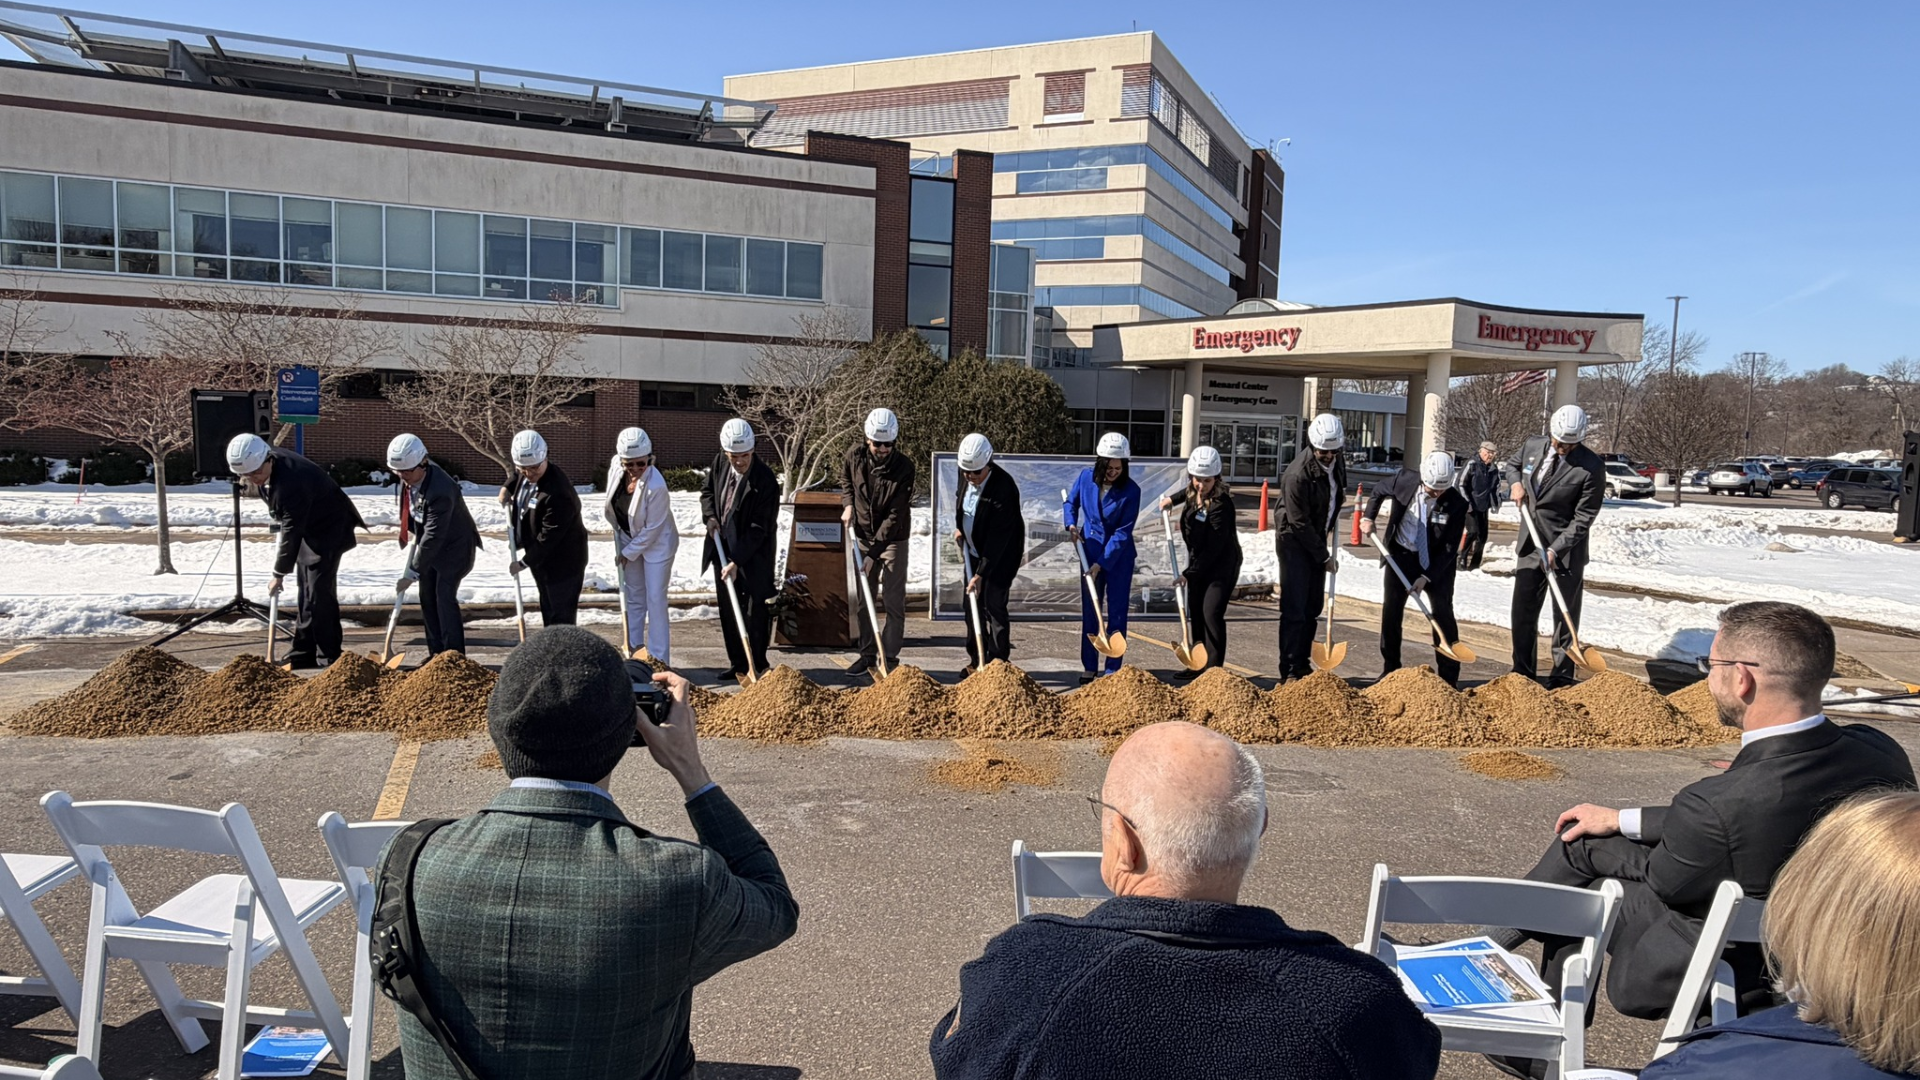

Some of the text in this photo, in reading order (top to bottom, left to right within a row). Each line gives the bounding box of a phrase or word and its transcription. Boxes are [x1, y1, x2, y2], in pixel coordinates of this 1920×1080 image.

[1192, 326, 1303, 352] Emergency
[1477, 314, 1597, 353] Emergency
[1209, 380, 1269, 390] Menard Center
[1213, 394, 1258, 405] Emergency
[1259, 397, 1277, 405] Care
